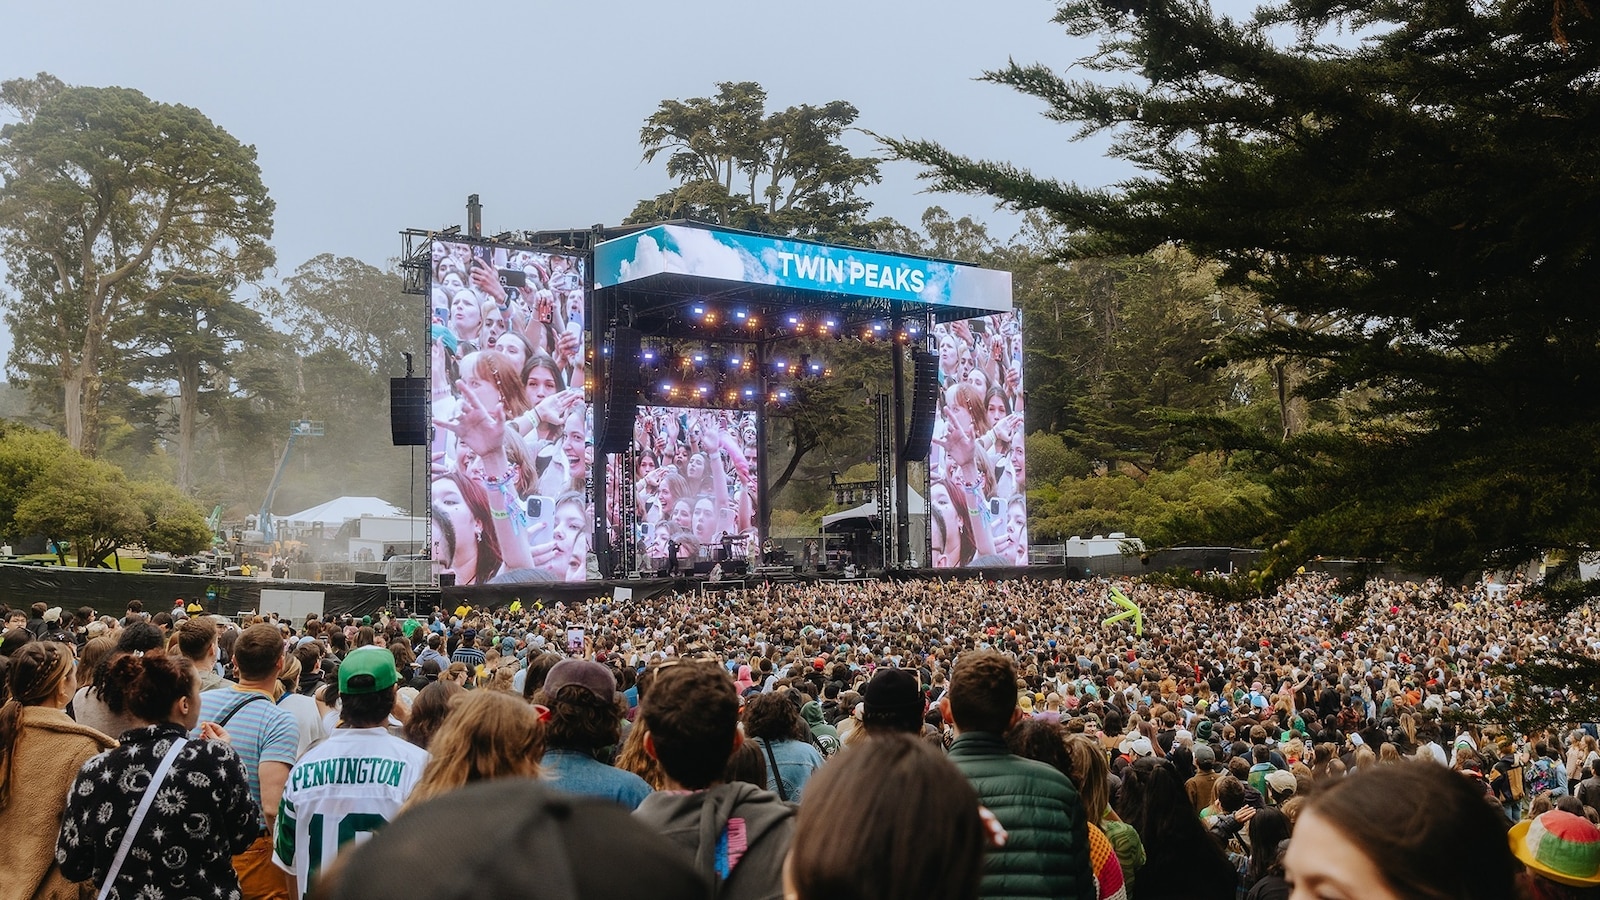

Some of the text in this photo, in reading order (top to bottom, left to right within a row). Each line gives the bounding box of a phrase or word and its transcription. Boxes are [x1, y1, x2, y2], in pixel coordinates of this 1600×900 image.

[778, 252, 925, 293] TWIN PEAKS
[292, 757, 406, 792] PENNINGTON
